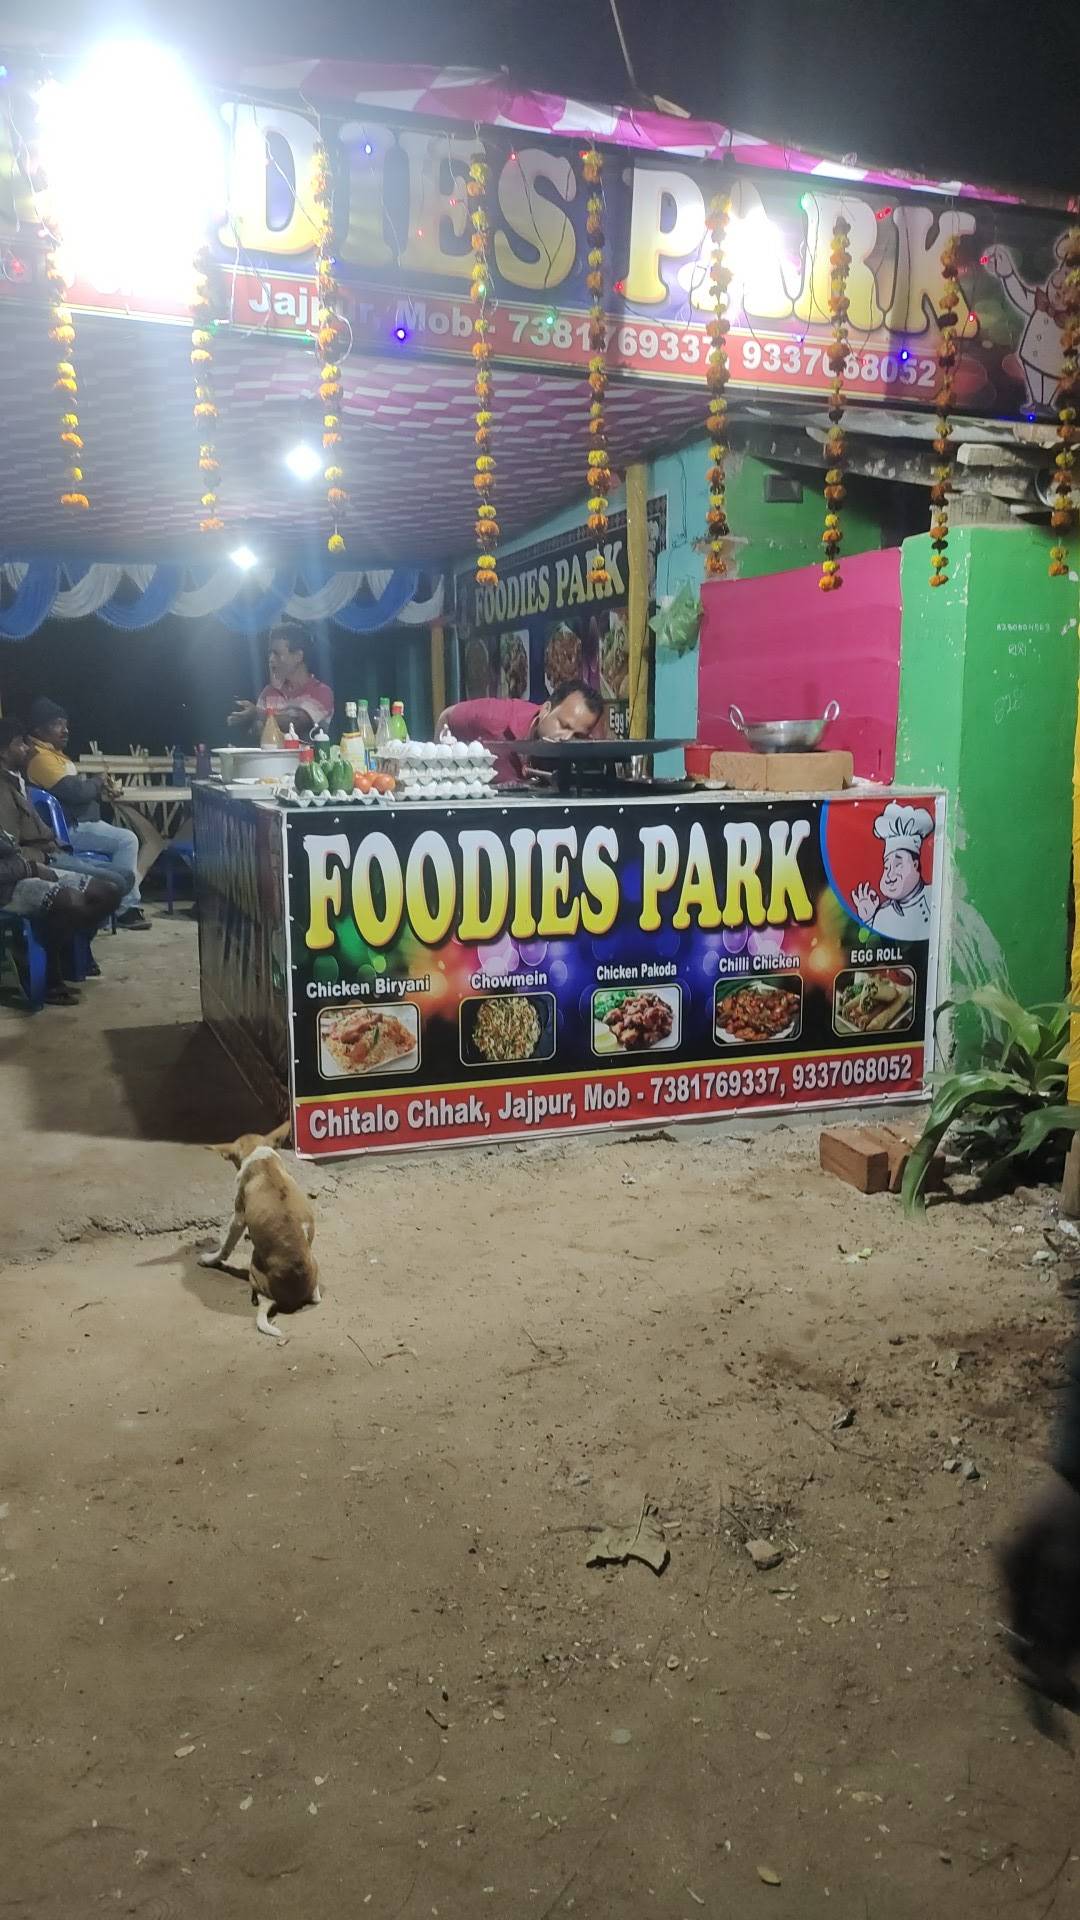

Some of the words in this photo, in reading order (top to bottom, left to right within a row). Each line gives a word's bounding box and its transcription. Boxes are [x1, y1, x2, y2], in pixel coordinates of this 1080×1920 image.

[622, 167, 980, 338] PARK
[398, 299, 475, 338] Mob
[609, 707, 624, 734] Egg
[303, 825, 620, 949] FOODIES
[639, 820, 813, 931] PARK
[719, 956, 749, 973] Chilli
[753, 954, 800, 970] Chicken
[850, 949, 873, 963] EGG
[876, 948, 902, 962] ROLL
[470, 971, 547, 990] Chowmein
[596, 964, 638, 981] Chicken
[641, 962, 677, 978] Pakoda
[306, 981, 370, 999] Chicken
[375, 974, 431, 996] Biryani
[309, 1102, 399, 1139] Chitalo
[407, 1095, 490, 1131] Chhak,
[498, 1090, 576, 1123] Jajpur,
[584, 1081, 630, 1111] Mob
[650, 1067, 785, 1106] 7381769337,
[792, 1054, 912, 1091] 9337068052
